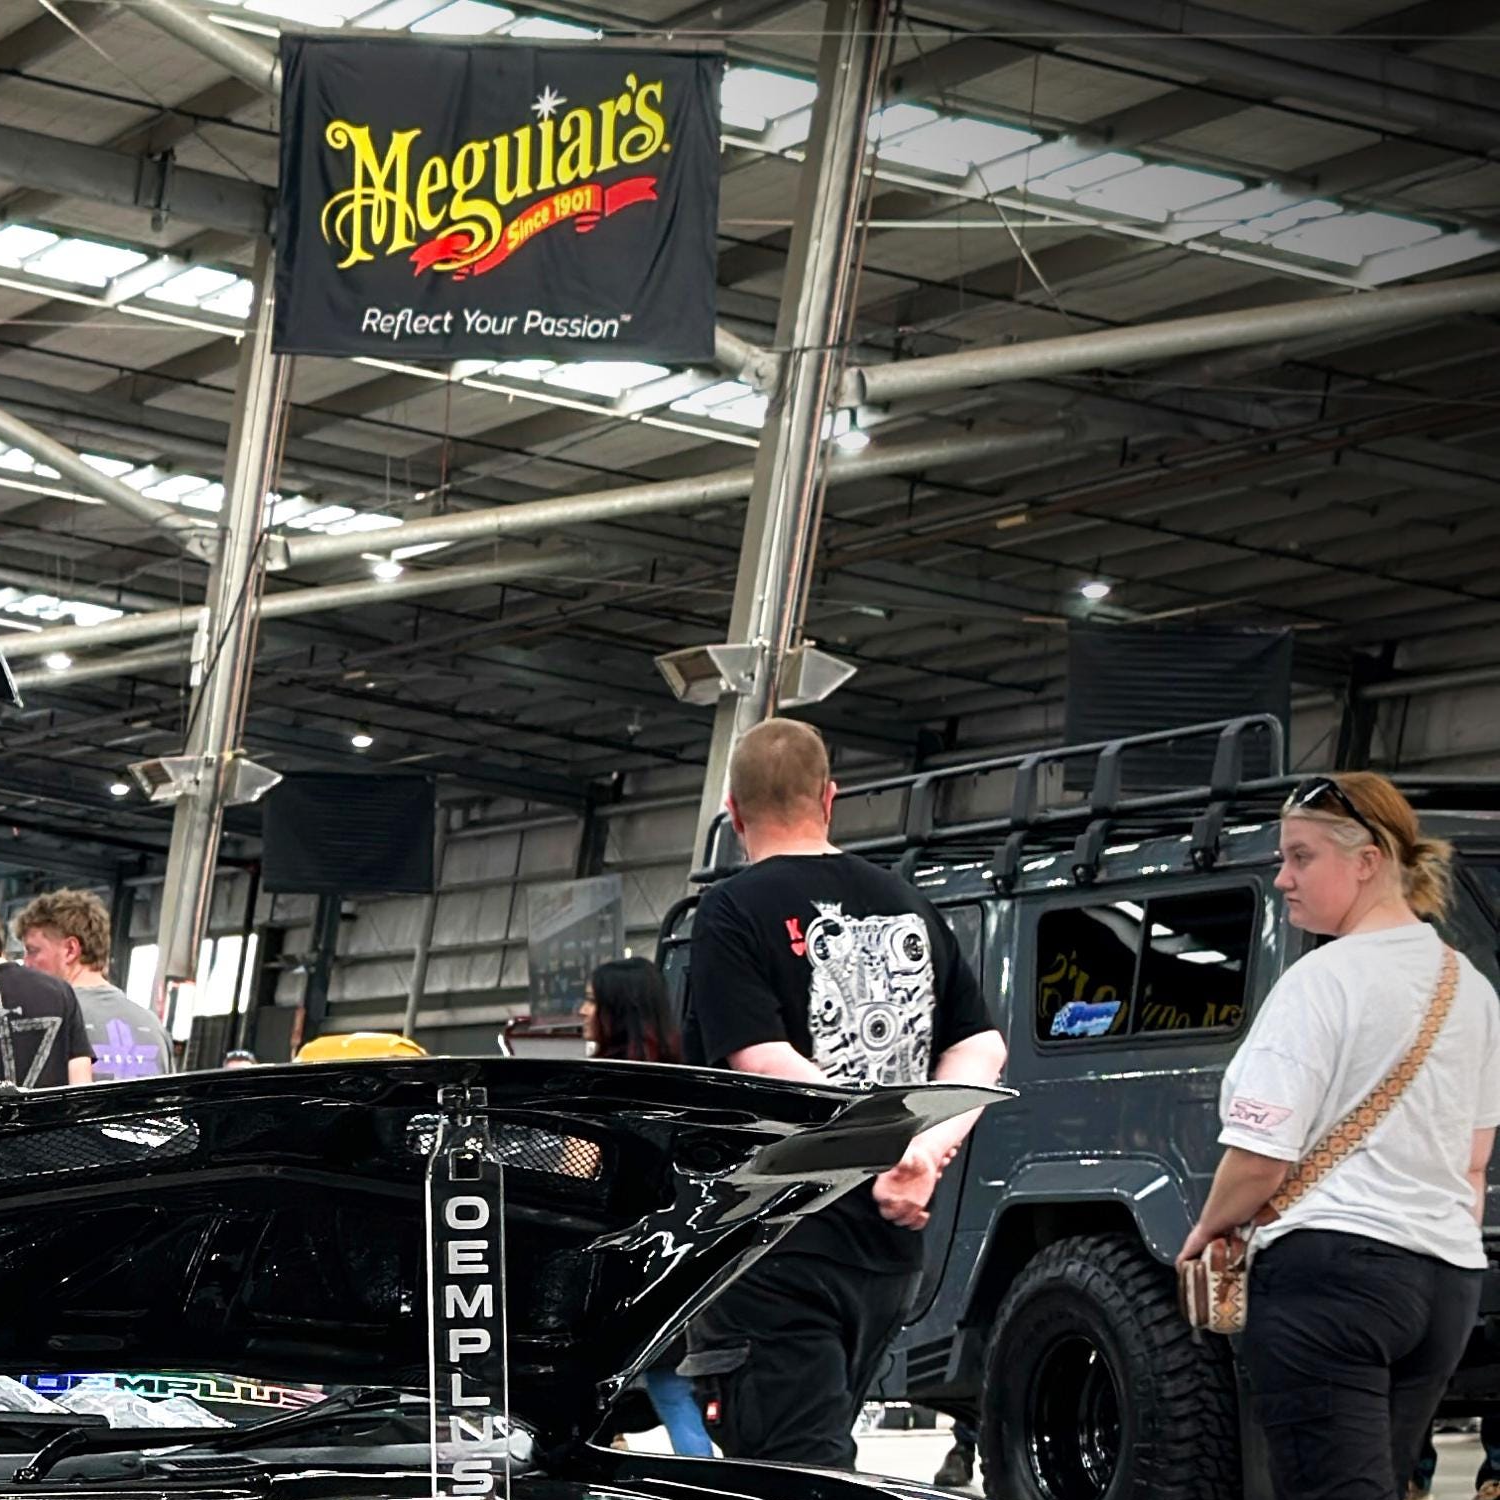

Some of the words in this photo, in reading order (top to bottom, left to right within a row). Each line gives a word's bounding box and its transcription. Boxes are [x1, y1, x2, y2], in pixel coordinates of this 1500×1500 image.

[506, 209, 550, 250] Since
[553, 189, 592, 218] 1901
[361, 307, 454, 340] Reflect
[463, 308, 517, 335] Your
